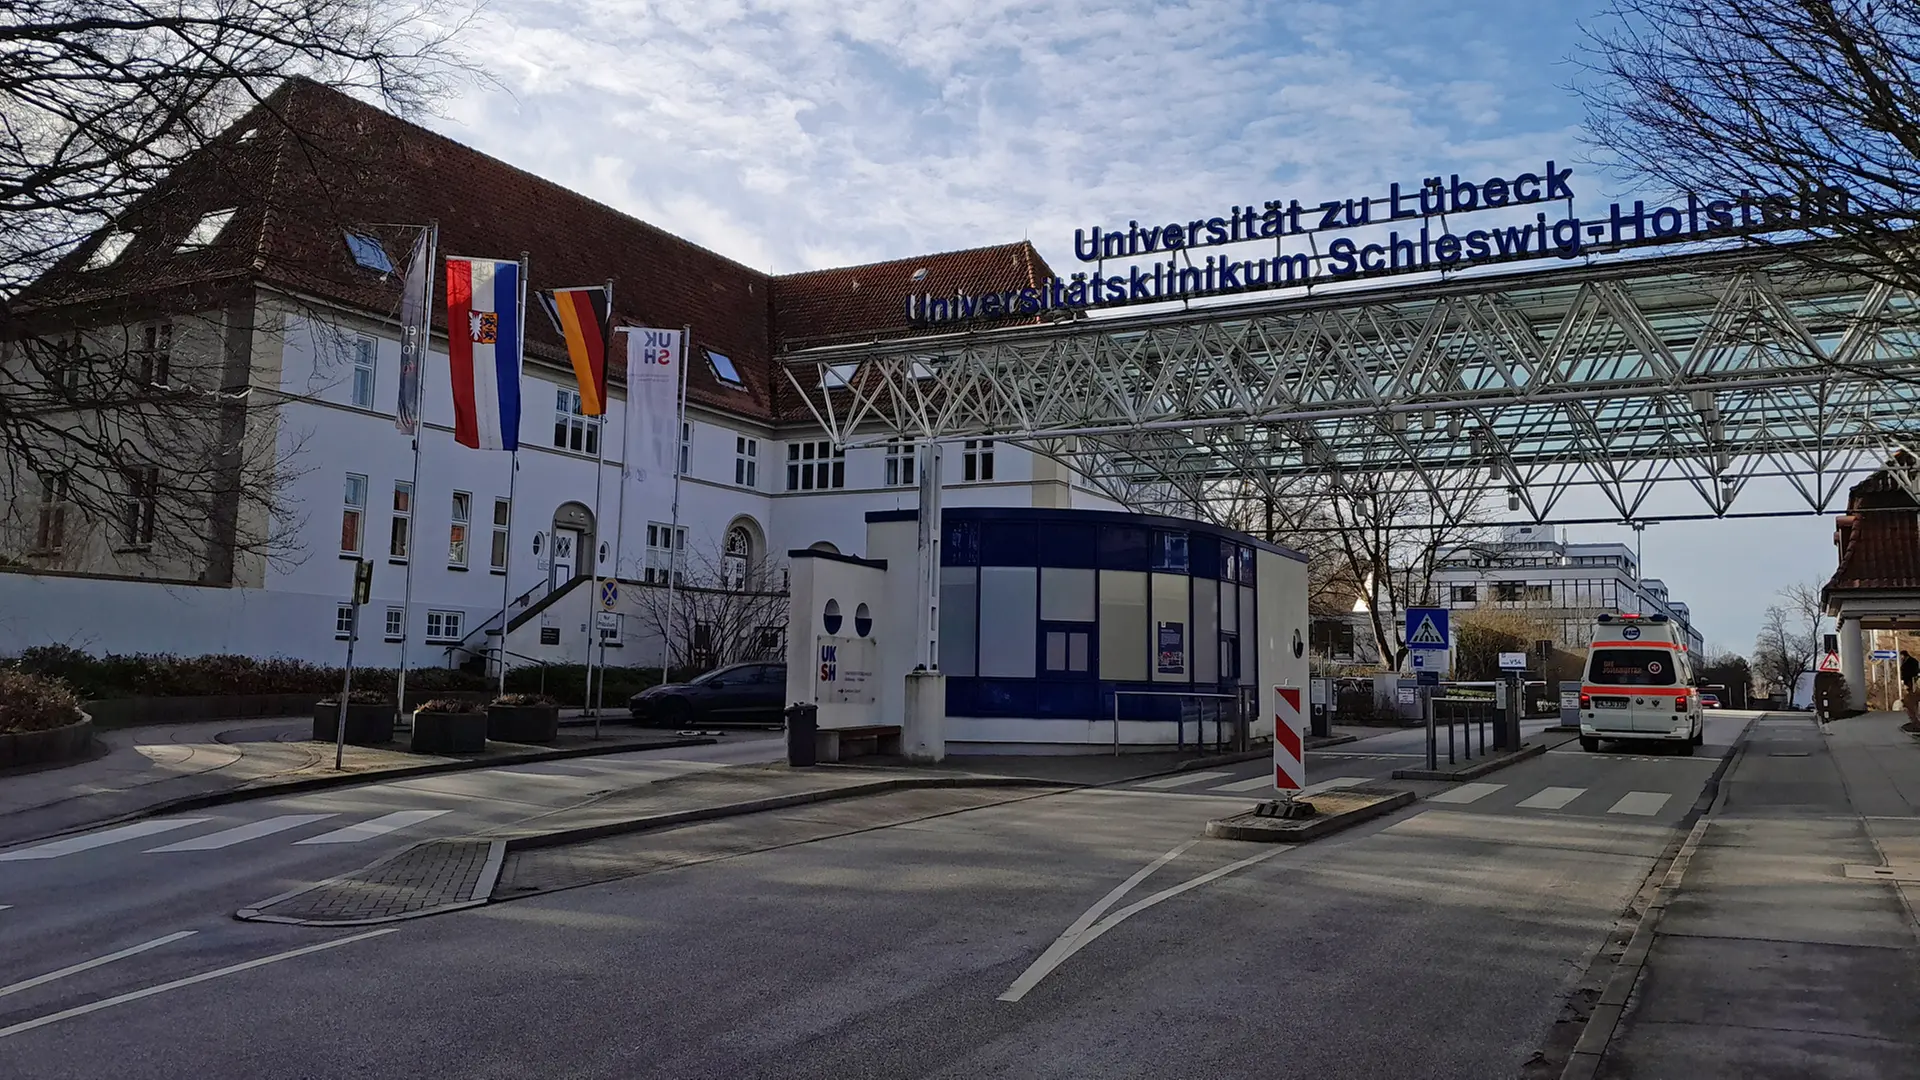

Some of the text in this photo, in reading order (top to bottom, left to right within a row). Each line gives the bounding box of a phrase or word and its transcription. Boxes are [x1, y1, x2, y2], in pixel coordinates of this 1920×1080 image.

[1074, 160, 1575, 262] Universität zu Lübeck
[905, 251, 1310, 327] Universitätsklinikum
[821, 645, 837, 662] UK
[821, 663, 836, 682] SH
